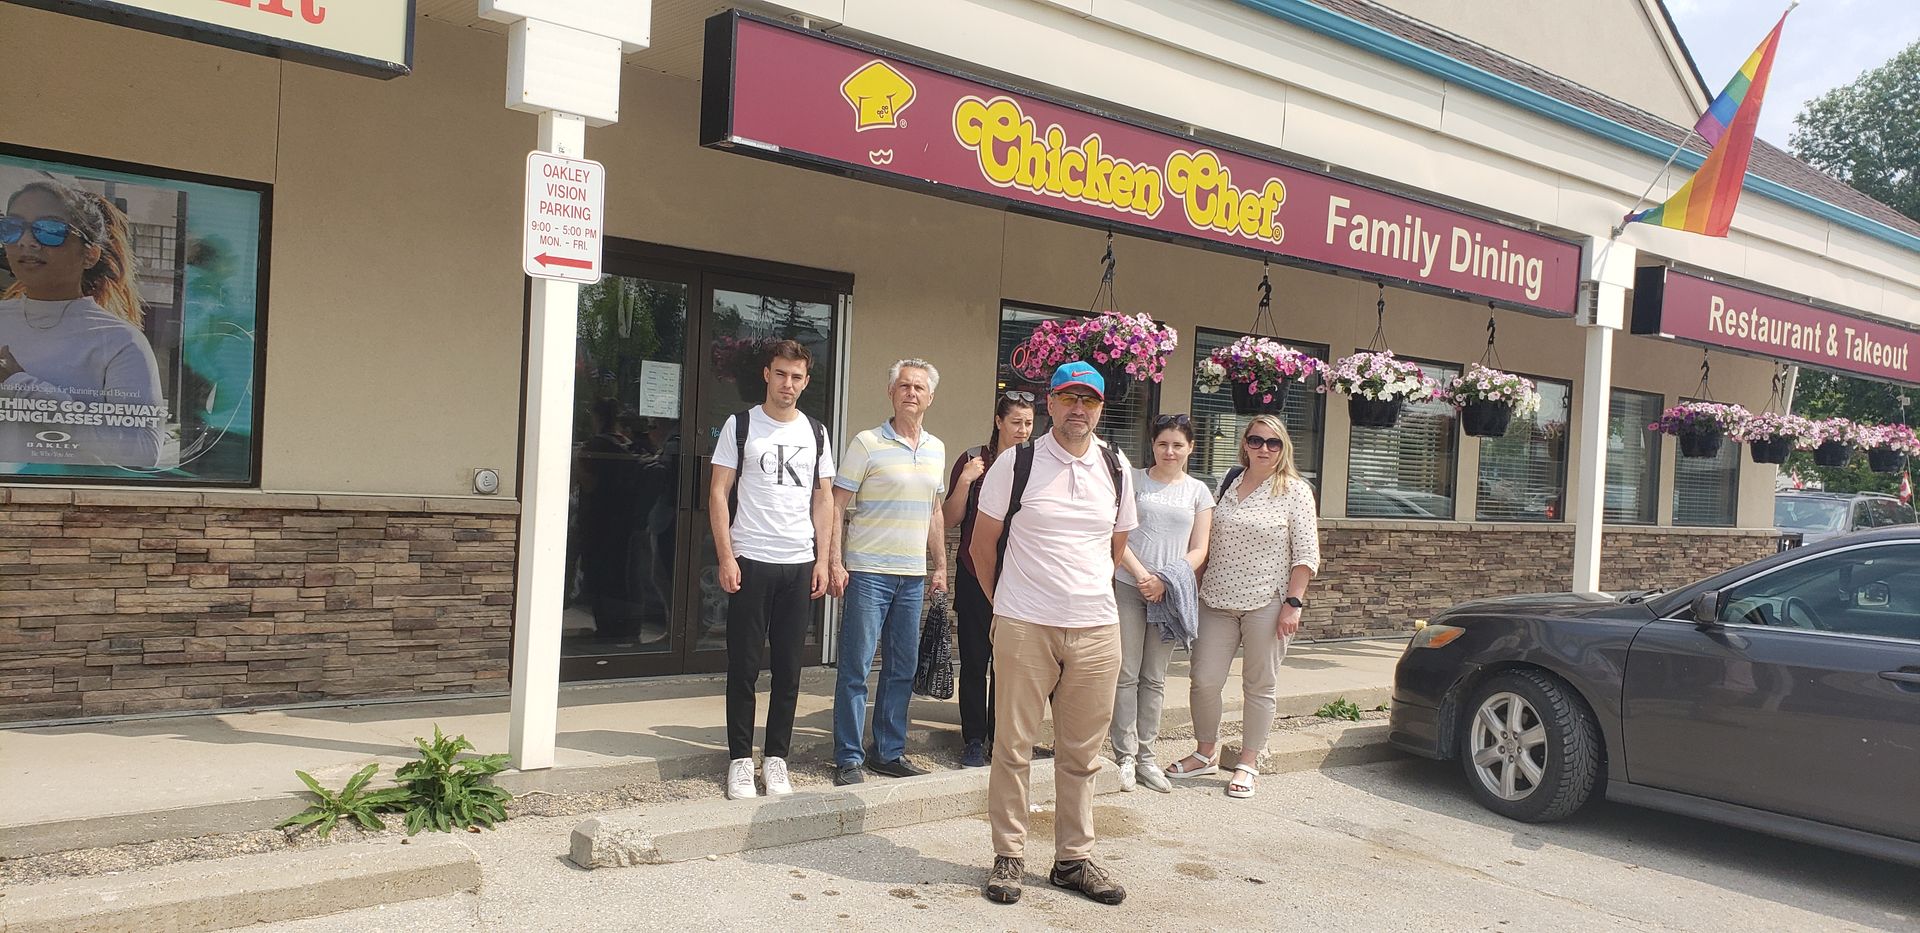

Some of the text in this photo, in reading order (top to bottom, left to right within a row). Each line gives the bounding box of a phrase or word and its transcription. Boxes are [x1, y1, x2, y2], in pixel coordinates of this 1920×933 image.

[543, 163, 590, 183] OAKLEY
[952, 96, 1285, 241] Chicken Chef
[546, 182, 587, 202] VISION
[539, 200, 591, 221] PARKING
[531, 220, 551, 232] 9:00
[562, 225, 581, 236] 5:00
[585, 228, 597, 239] PM
[539, 235, 562, 248] MON.
[573, 239, 588, 251] FRI.
[1326, 195, 1543, 301] Family Dining
[1708, 295, 1909, 371] Restaurant & Takeout
[70, 386, 99, 397] Running
[100, 388, 113, 396] and
[0, 410, 160, 428] SUNGLASSES WON'T
[61, 400, 86, 413] GO
[89, 402, 173, 419] SIDEWAYS,
